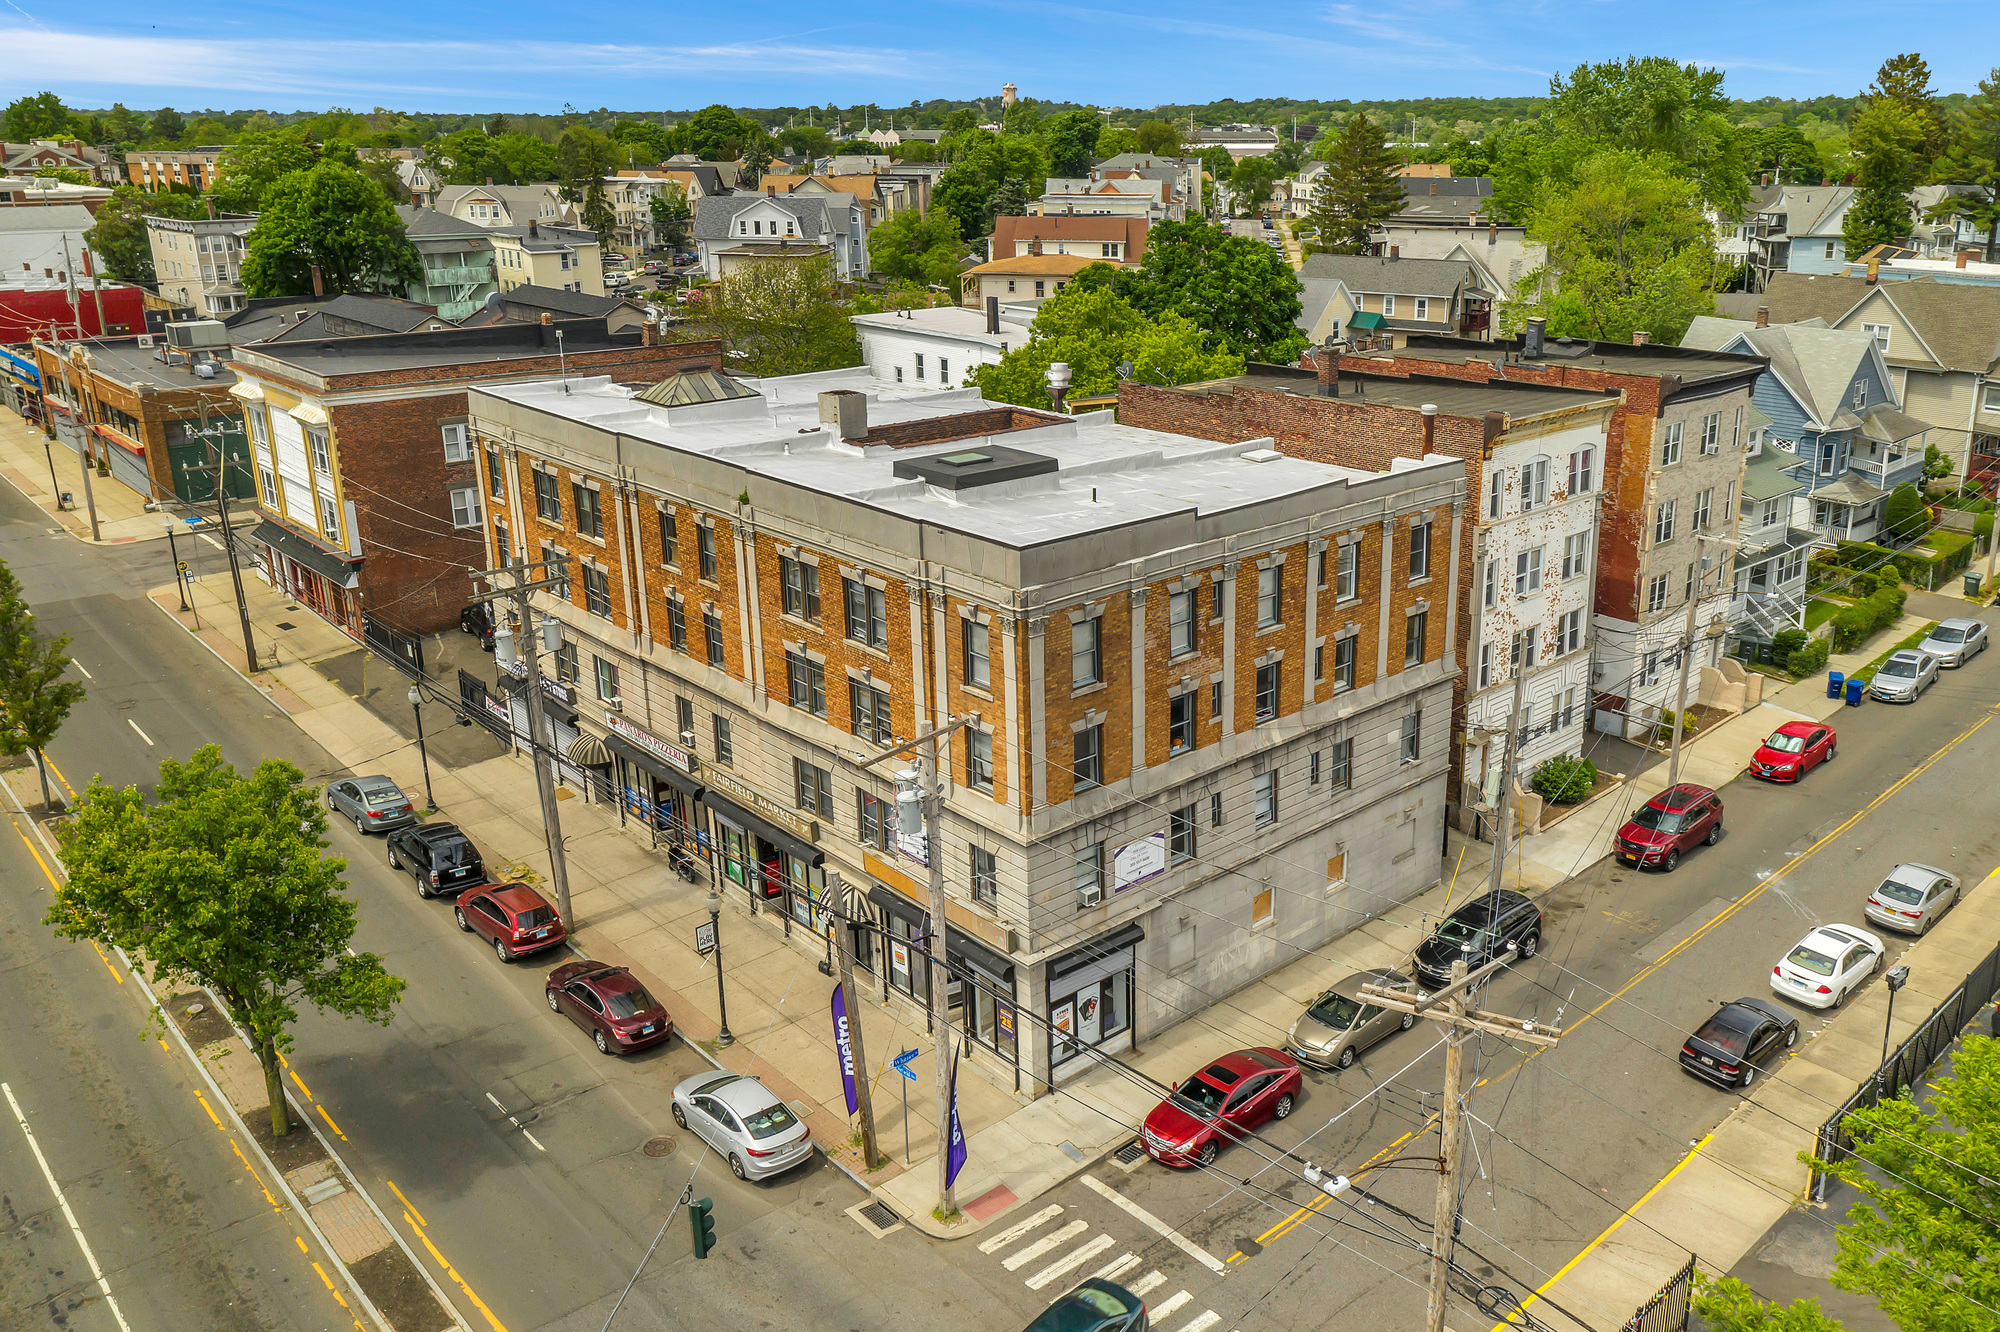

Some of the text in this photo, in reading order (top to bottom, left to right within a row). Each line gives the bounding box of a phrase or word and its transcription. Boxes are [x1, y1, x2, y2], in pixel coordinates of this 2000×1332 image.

[619, 719, 653, 745] PANARO'S
[653, 738, 687, 765] PIZZERIA
[712, 770, 755, 801] FAIRFIELD
[758, 796, 797, 826] MARKET
[700, 933, 712, 942] PLAY
[700, 937, 713, 947] HERE
[837, 1015, 855, 1076] metro
